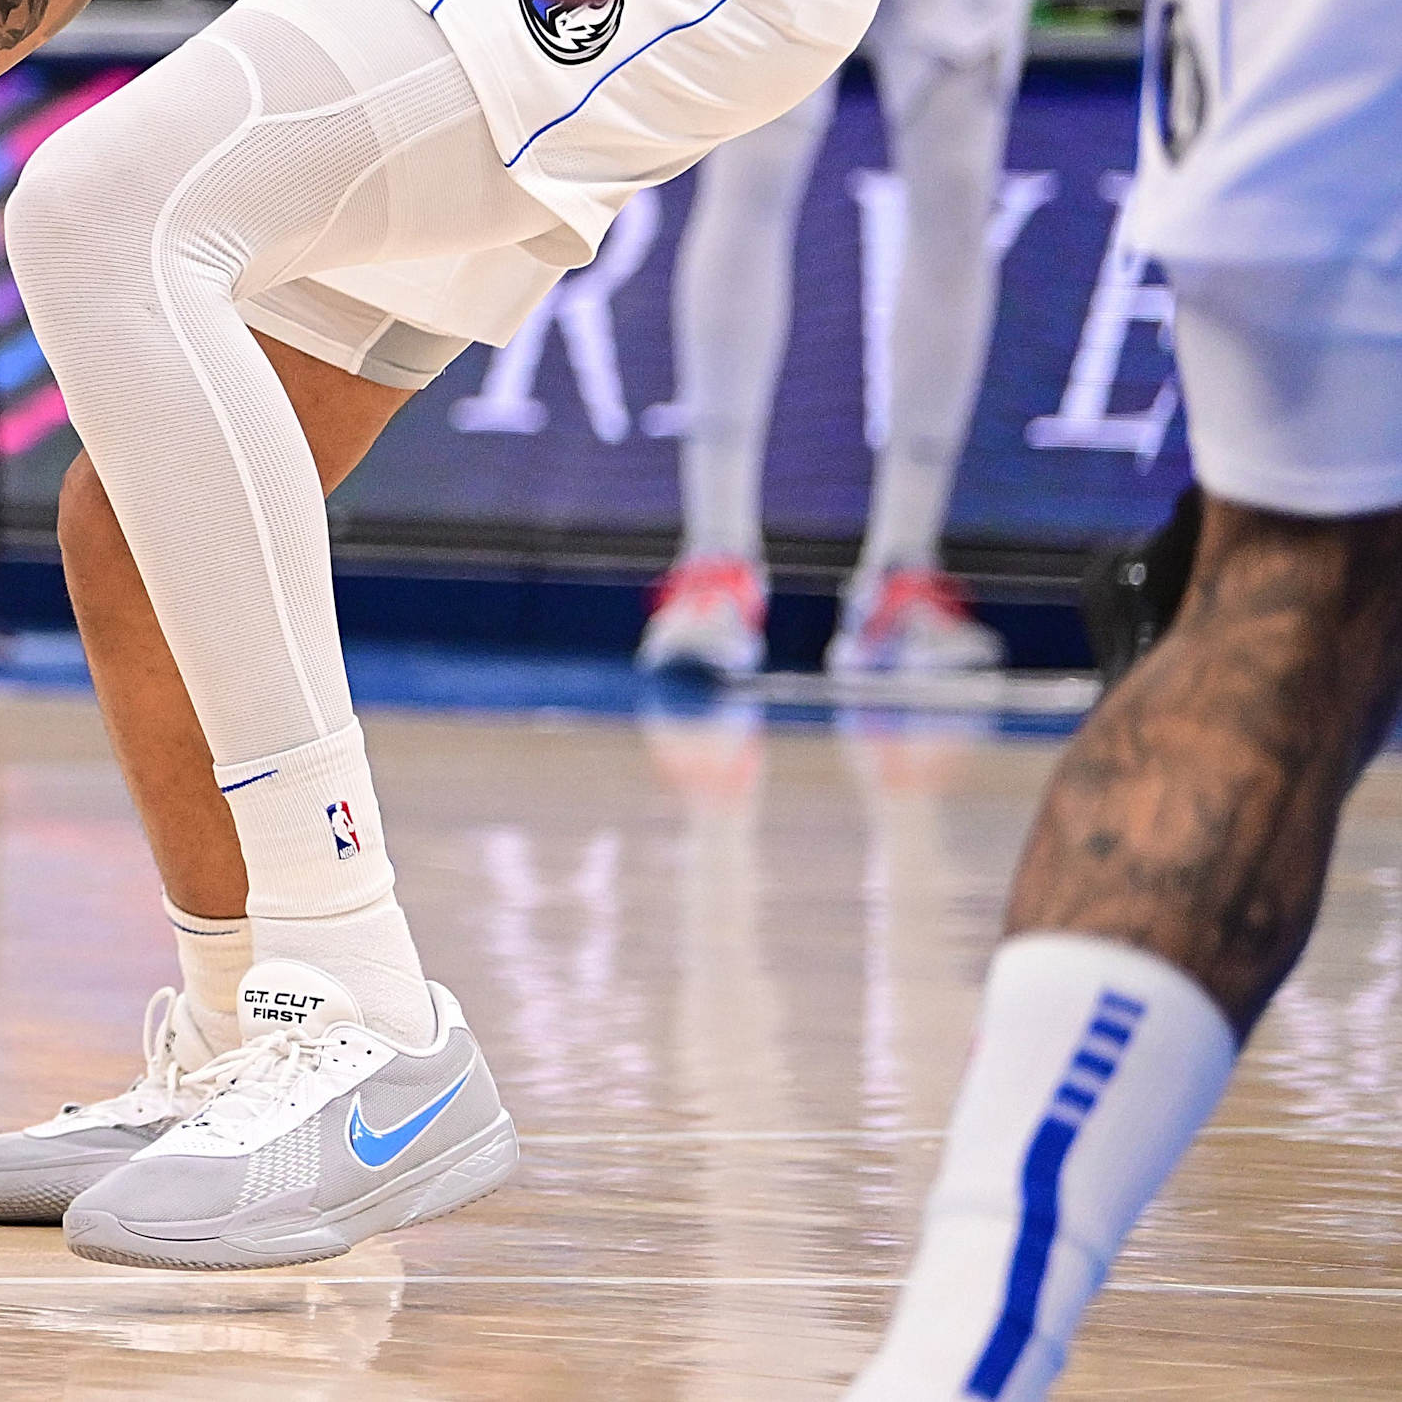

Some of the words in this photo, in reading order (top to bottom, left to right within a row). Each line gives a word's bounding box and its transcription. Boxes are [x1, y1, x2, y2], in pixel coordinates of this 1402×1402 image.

[244, 989, 269, 1004] G.T.
[274, 992, 325, 1010] CUT
[253, 1007, 308, 1024] FIRST
